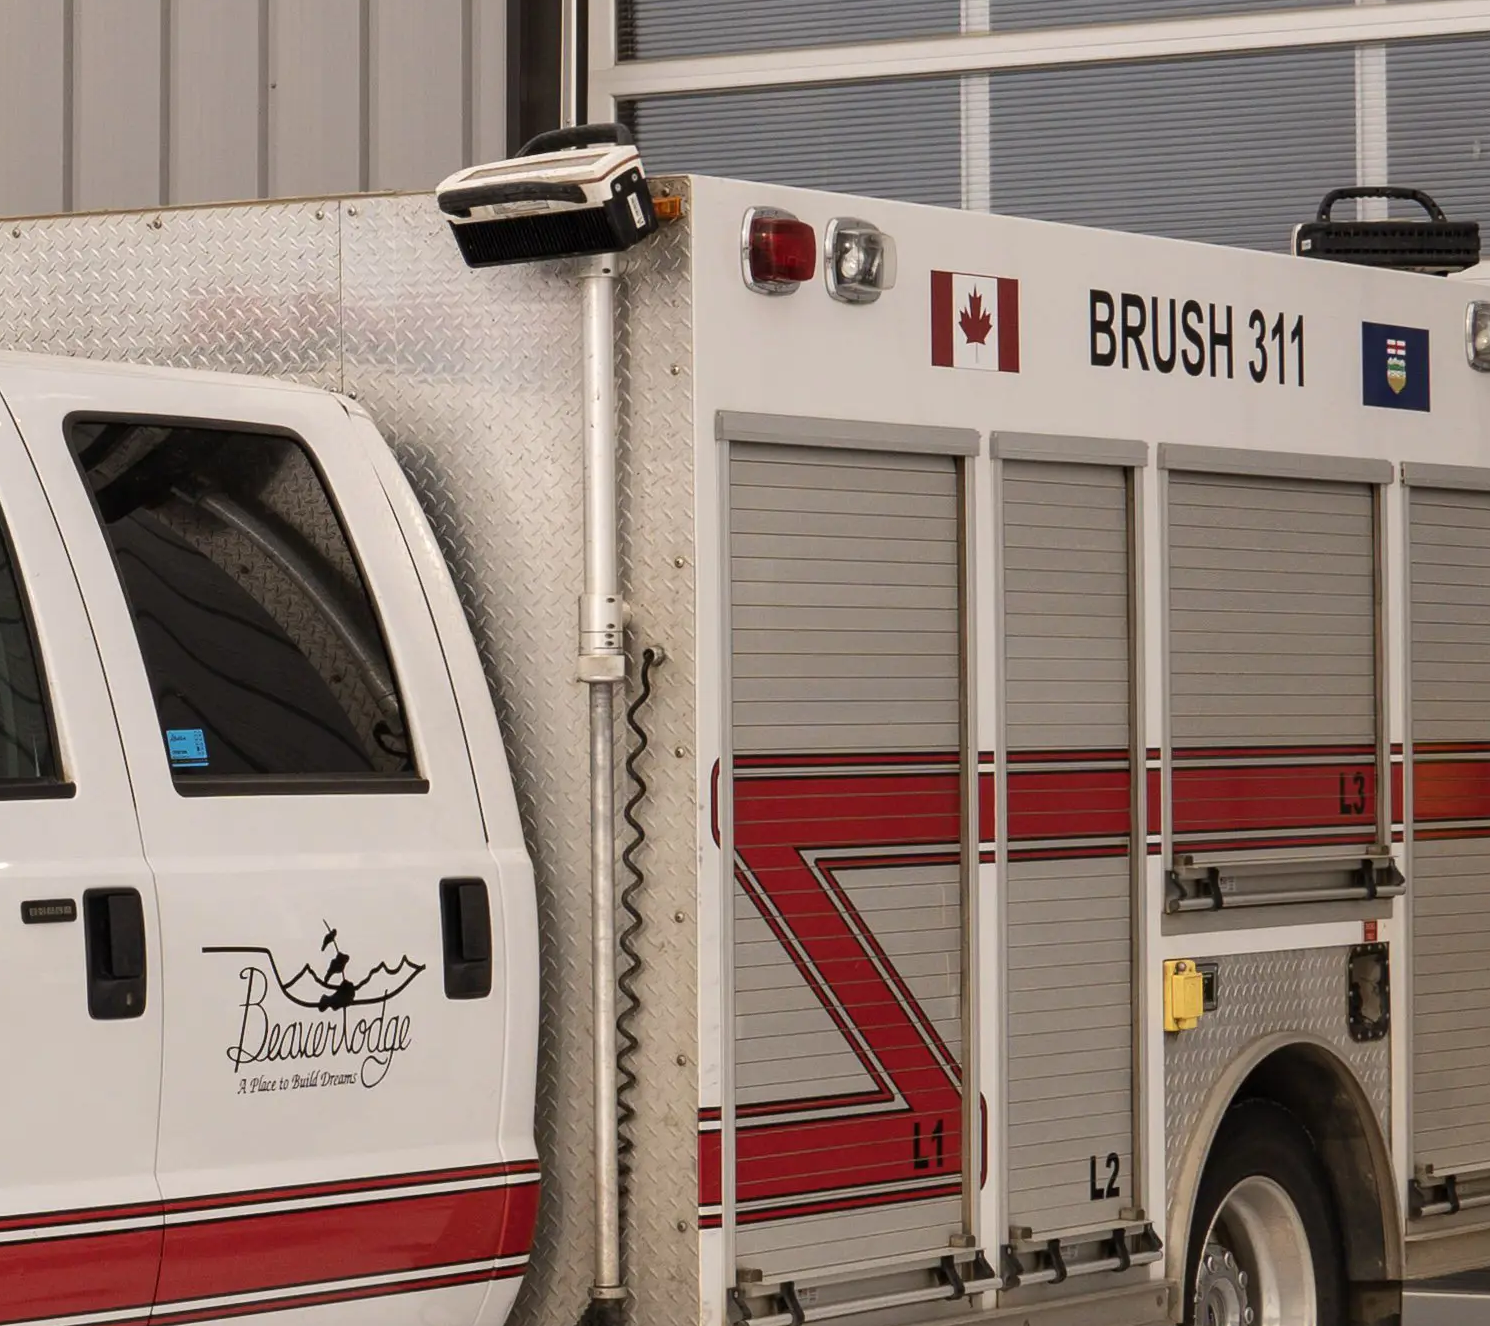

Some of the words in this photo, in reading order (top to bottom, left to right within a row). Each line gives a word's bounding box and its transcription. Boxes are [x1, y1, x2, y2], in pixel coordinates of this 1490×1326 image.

[1089, 289, 1234, 379] BRUSH
[1248, 309, 1305, 387] 311
[1339, 770, 1368, 817] L3
[226, 966, 412, 1089] Beaverlodge
[237, 1078, 247, 1095] A
[249, 1074, 277, 1094] Place
[279, 1076, 290, 1091] to
[291, 1069, 321, 1090] Build
[320, 1071, 359, 1088] Dreams
[912, 1118, 946, 1172] L1
[1089, 1152, 1121, 1201] L2
